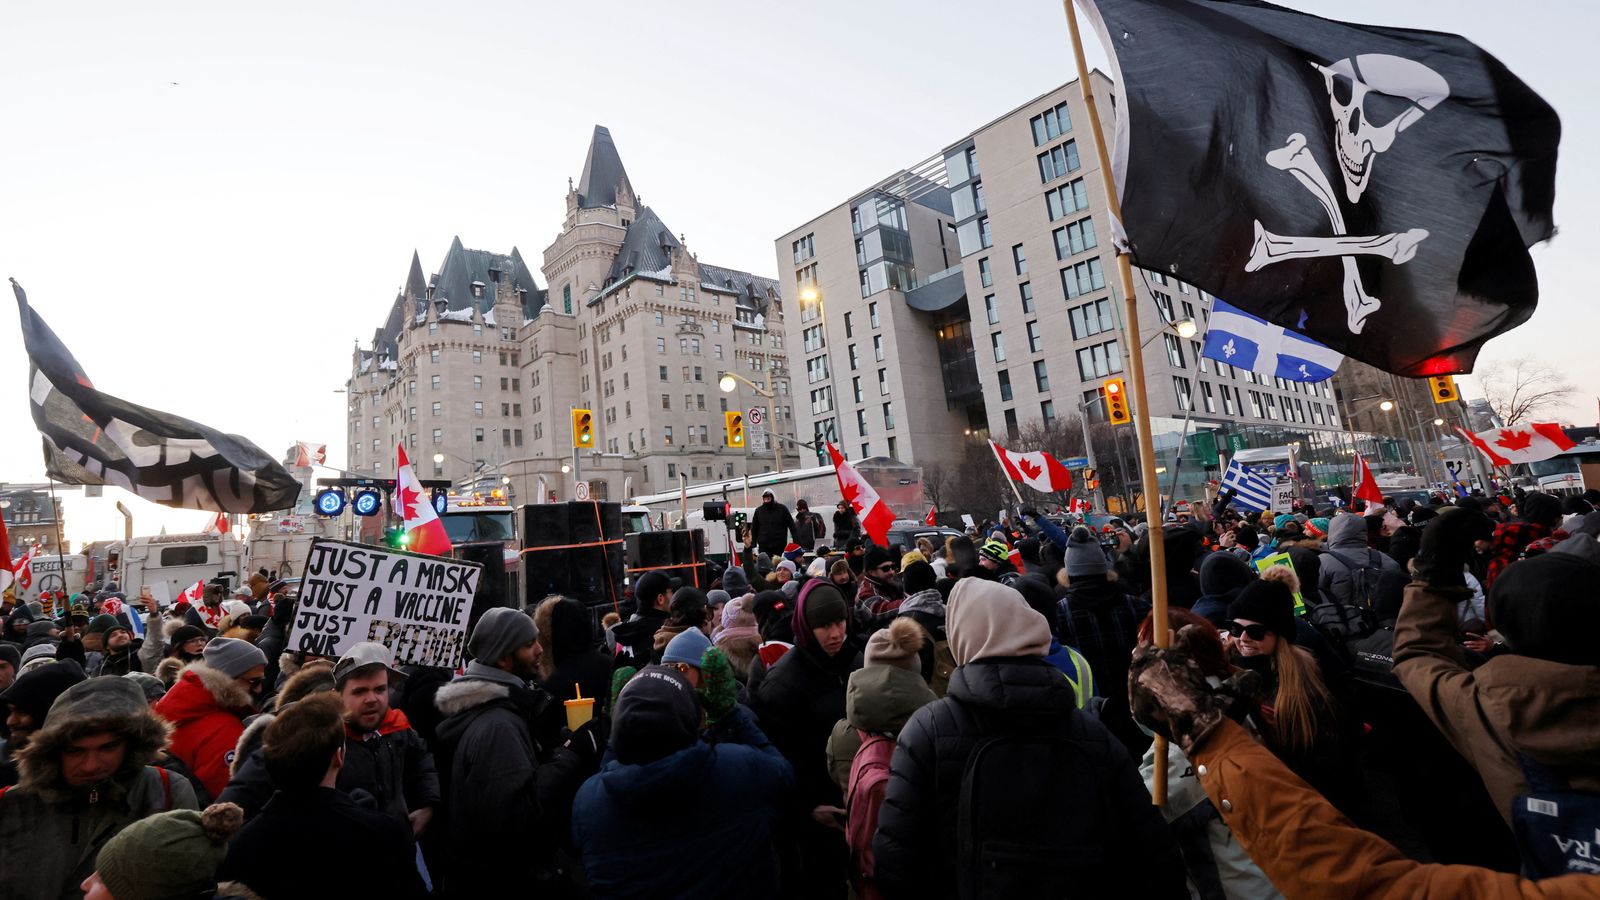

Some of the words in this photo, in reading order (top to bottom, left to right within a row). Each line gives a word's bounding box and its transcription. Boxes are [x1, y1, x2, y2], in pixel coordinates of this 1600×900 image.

[309, 545, 388, 581] JUST
[388, 558, 409, 585] A
[415, 562, 477, 594] MASK
[303, 579, 358, 612] JUST
[364, 586, 382, 615] A
[394, 590, 466, 625] VACCINE
[297, 611, 357, 636] JUST
[299, 632, 340, 656] OUR
[367, 619, 464, 668] FREEDOM
[663, 674, 683, 691] MOVE
